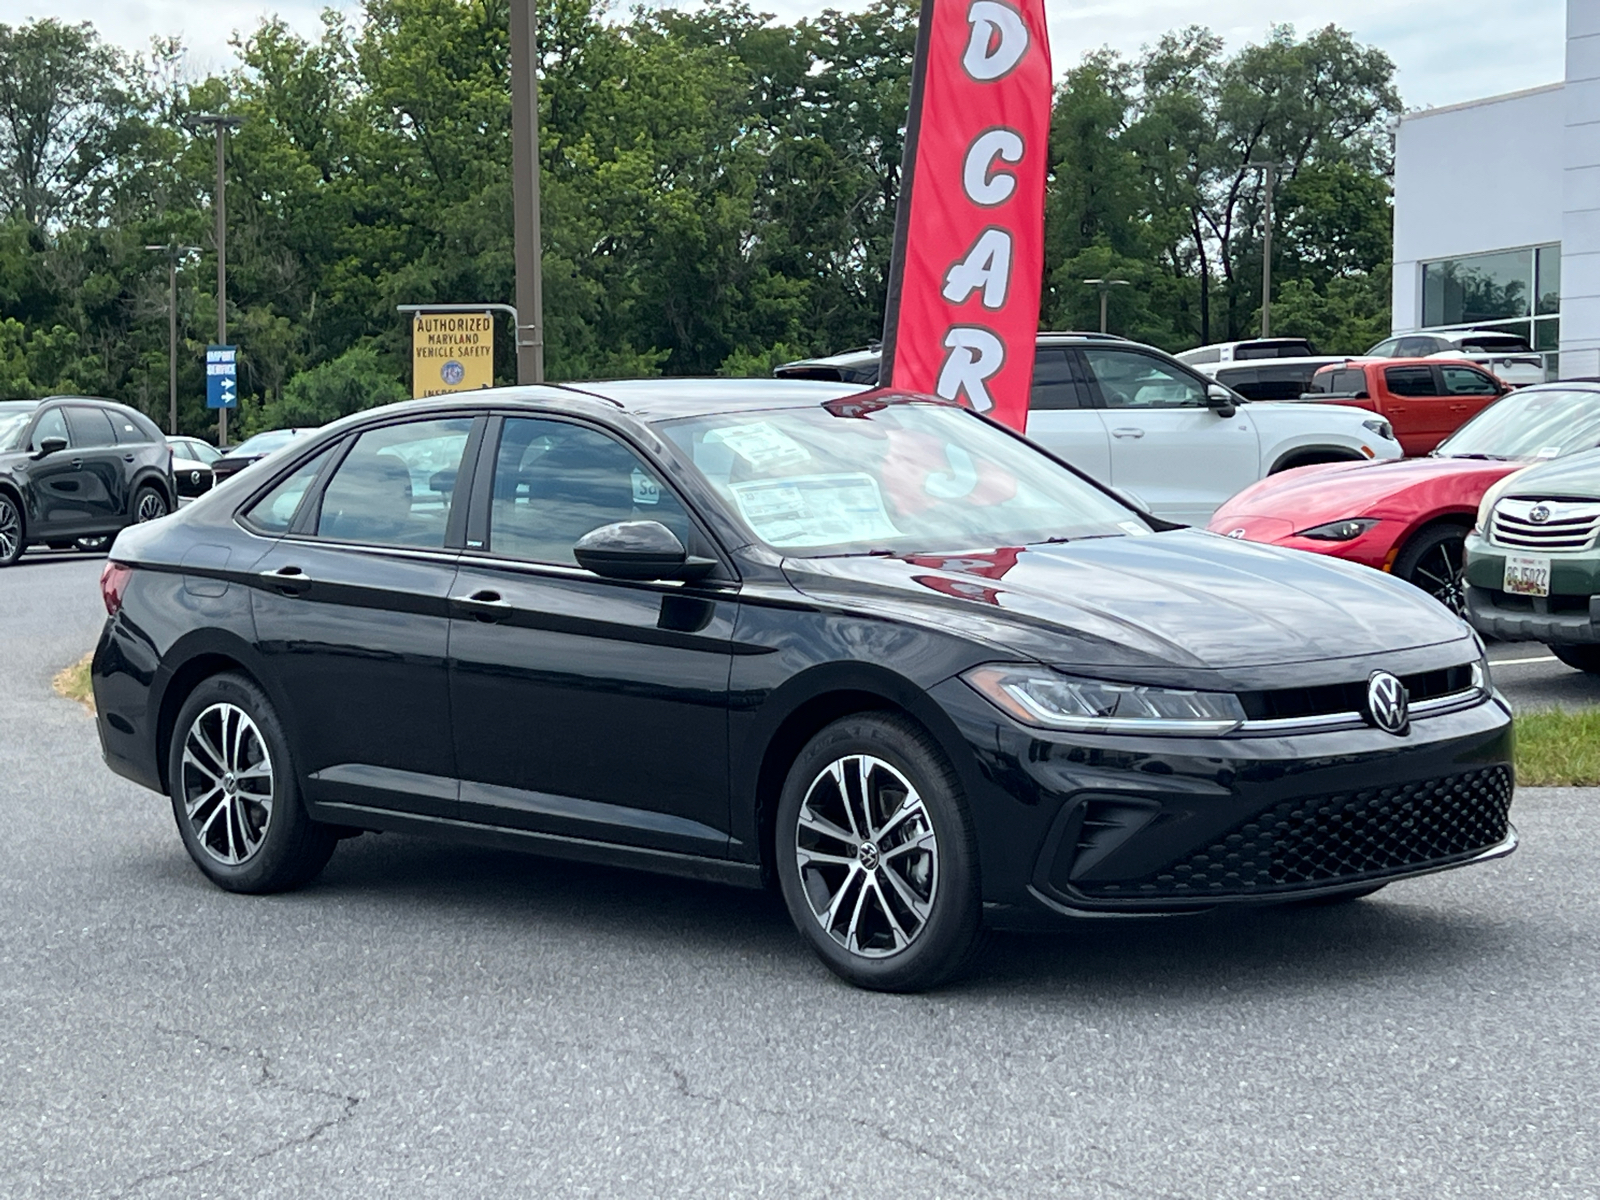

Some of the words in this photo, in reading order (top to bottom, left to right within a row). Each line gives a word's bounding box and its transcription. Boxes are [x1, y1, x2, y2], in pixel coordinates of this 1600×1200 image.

[417, 318, 490, 332] AUTHORIZED
[428, 333, 479, 344] MARYLAND
[416, 346, 454, 358] VEHICLE
[458, 346, 491, 357] SAFETY
